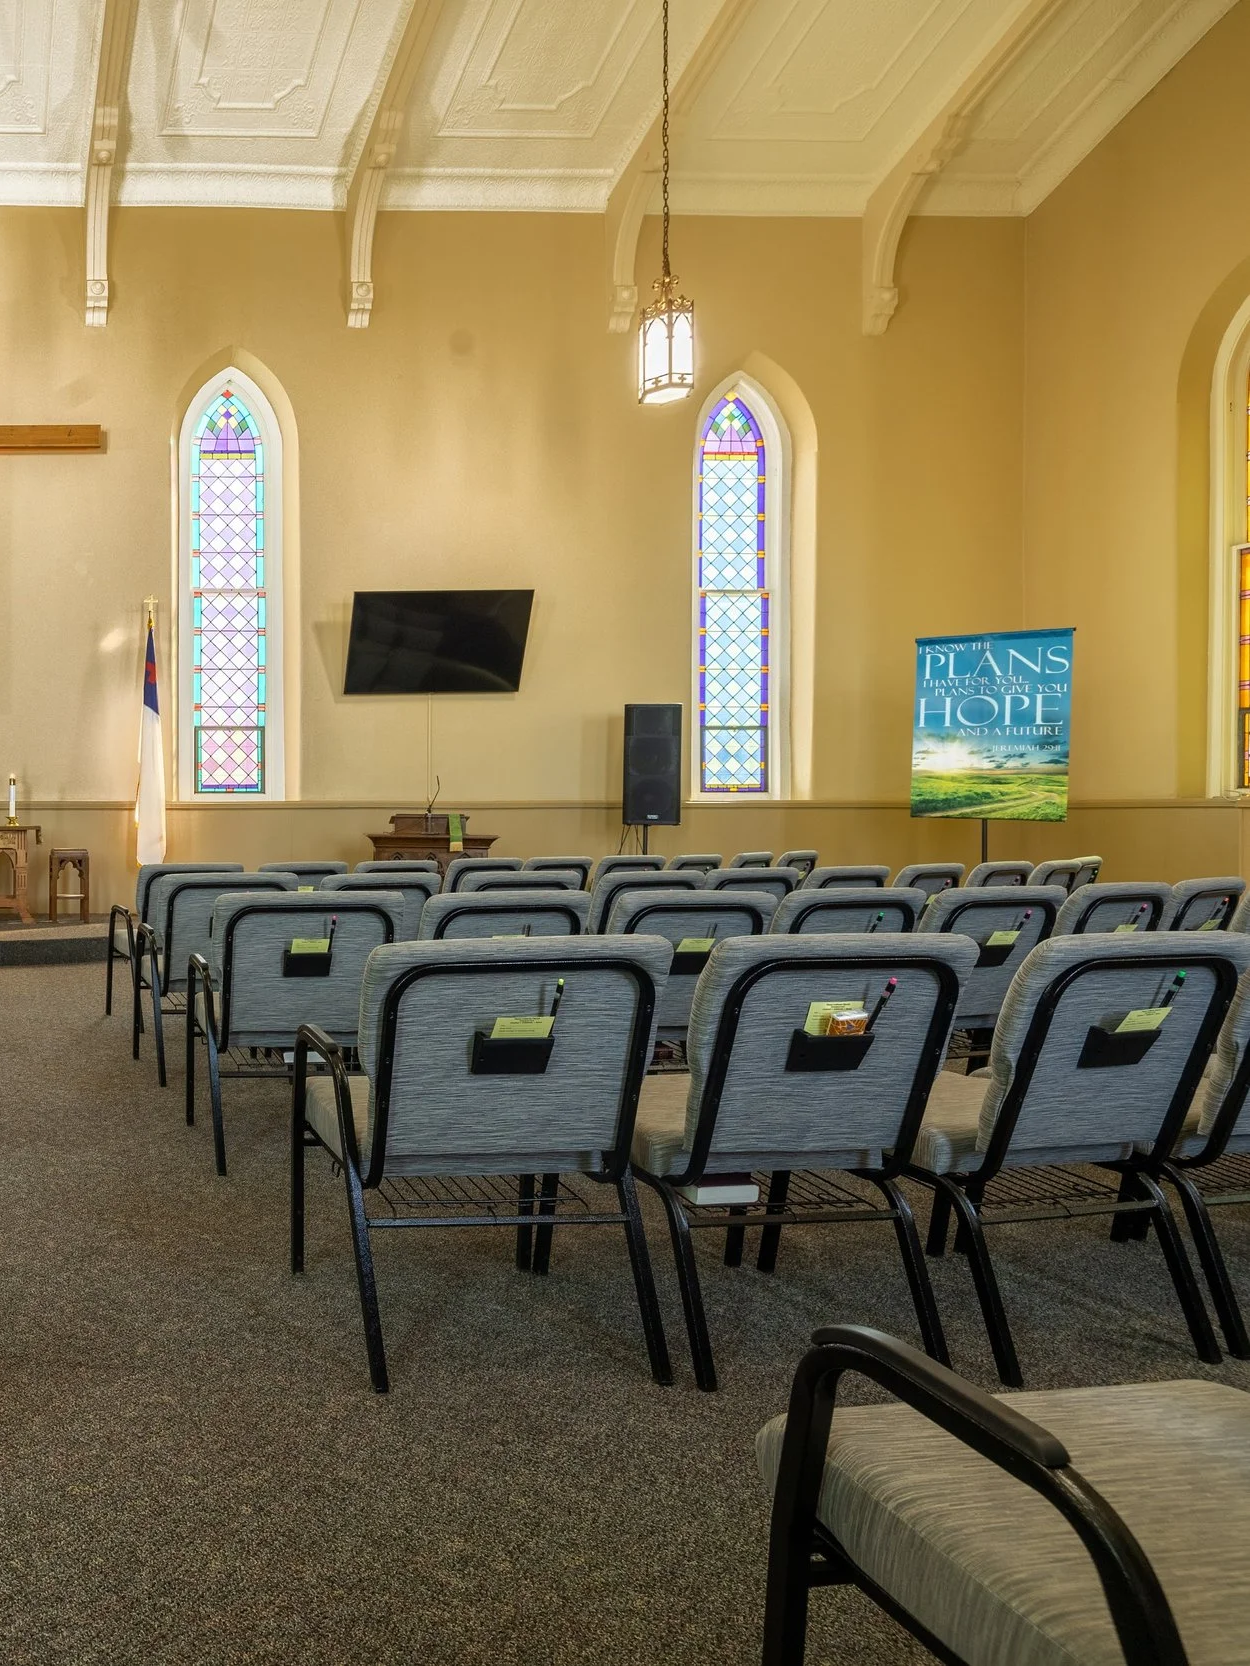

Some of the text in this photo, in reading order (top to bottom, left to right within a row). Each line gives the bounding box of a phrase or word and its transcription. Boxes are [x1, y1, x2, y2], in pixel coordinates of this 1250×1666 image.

[926, 644, 967, 654] KNOW
[970, 642, 994, 651] THE
[924, 646, 1070, 680] PLANS
[930, 680, 962, 688] HAVE
[966, 676, 990, 686] FOR
[934, 684, 1068, 697] PLANS TO GIVE YOU
[918, 694, 1064, 728] HOPE
[958, 726, 1063, 737] AND A FUTURE
